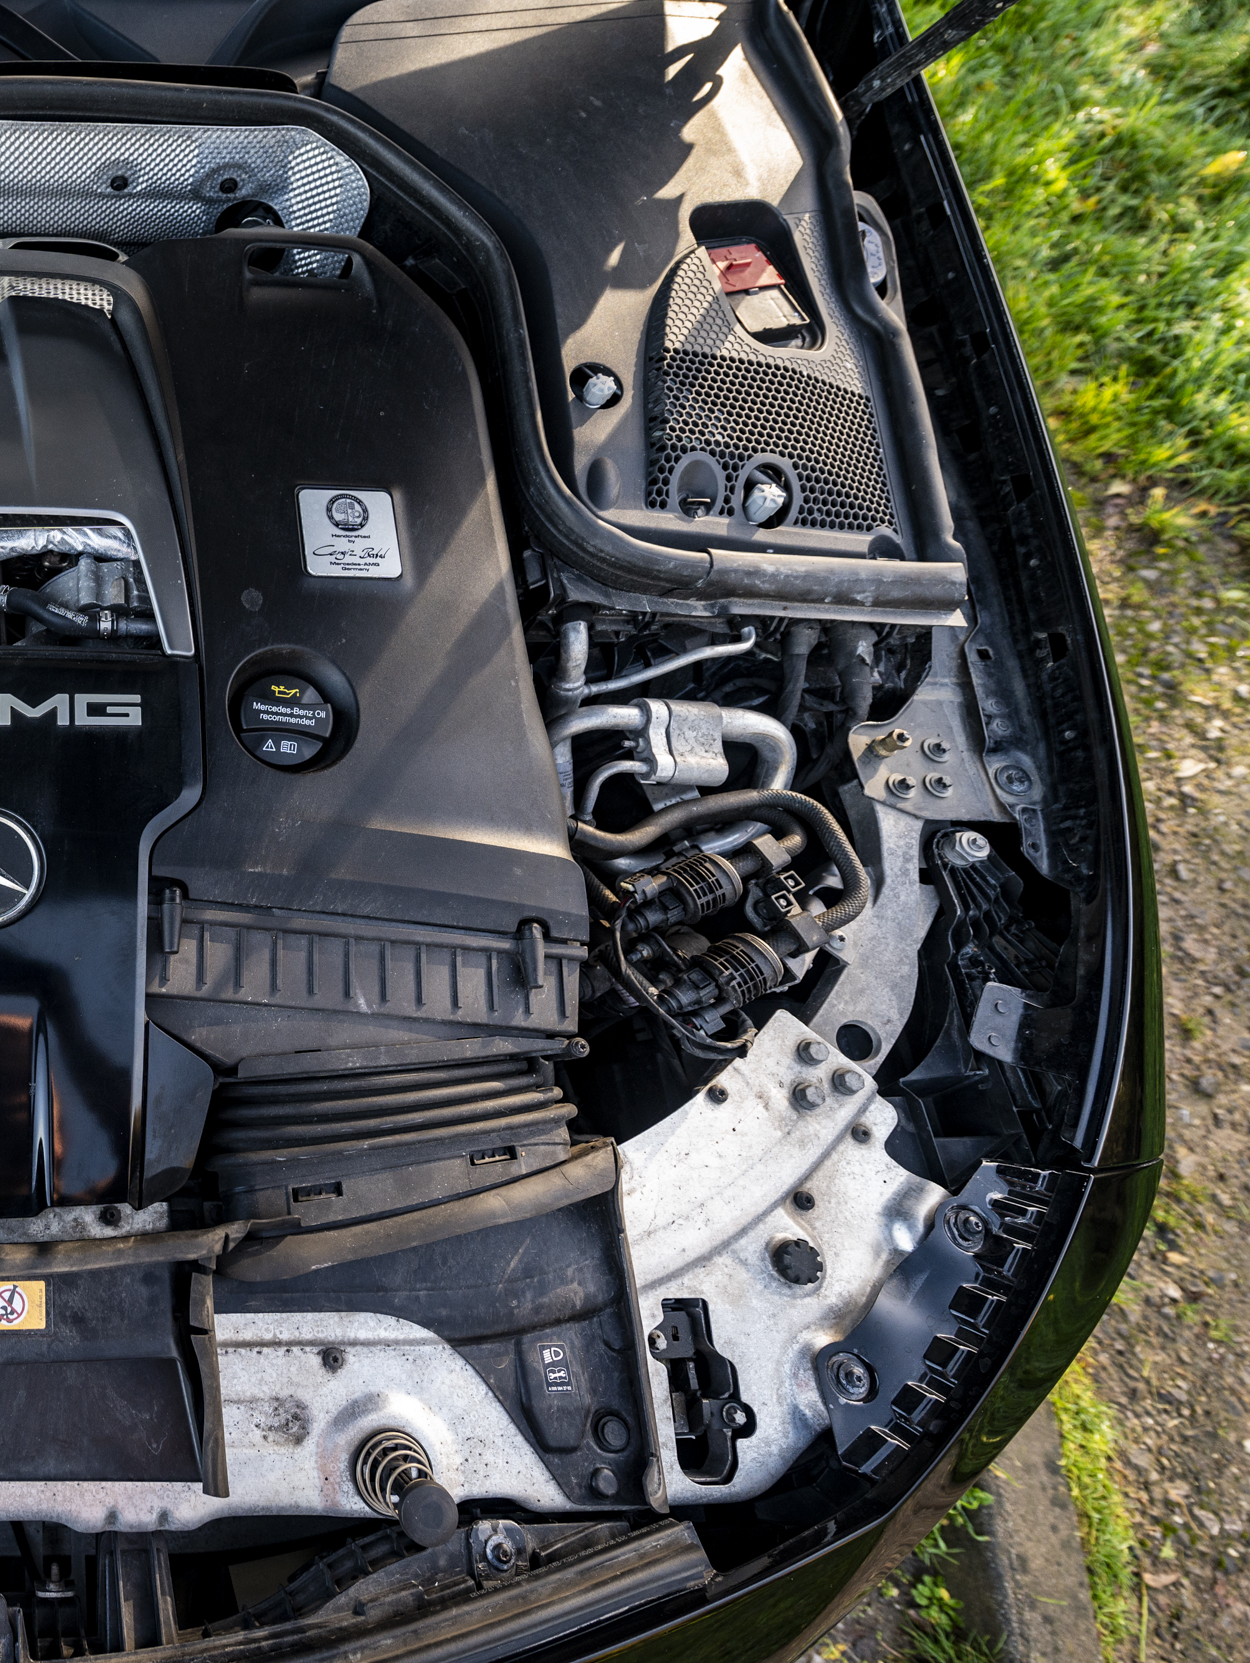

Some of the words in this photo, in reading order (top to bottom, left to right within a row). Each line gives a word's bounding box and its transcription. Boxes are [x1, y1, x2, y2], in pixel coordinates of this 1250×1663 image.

[252, 701, 313, 717] Mercedes-Benz
[314, 709, 326, 718] Oil
[259, 712, 316, 726] recommended
